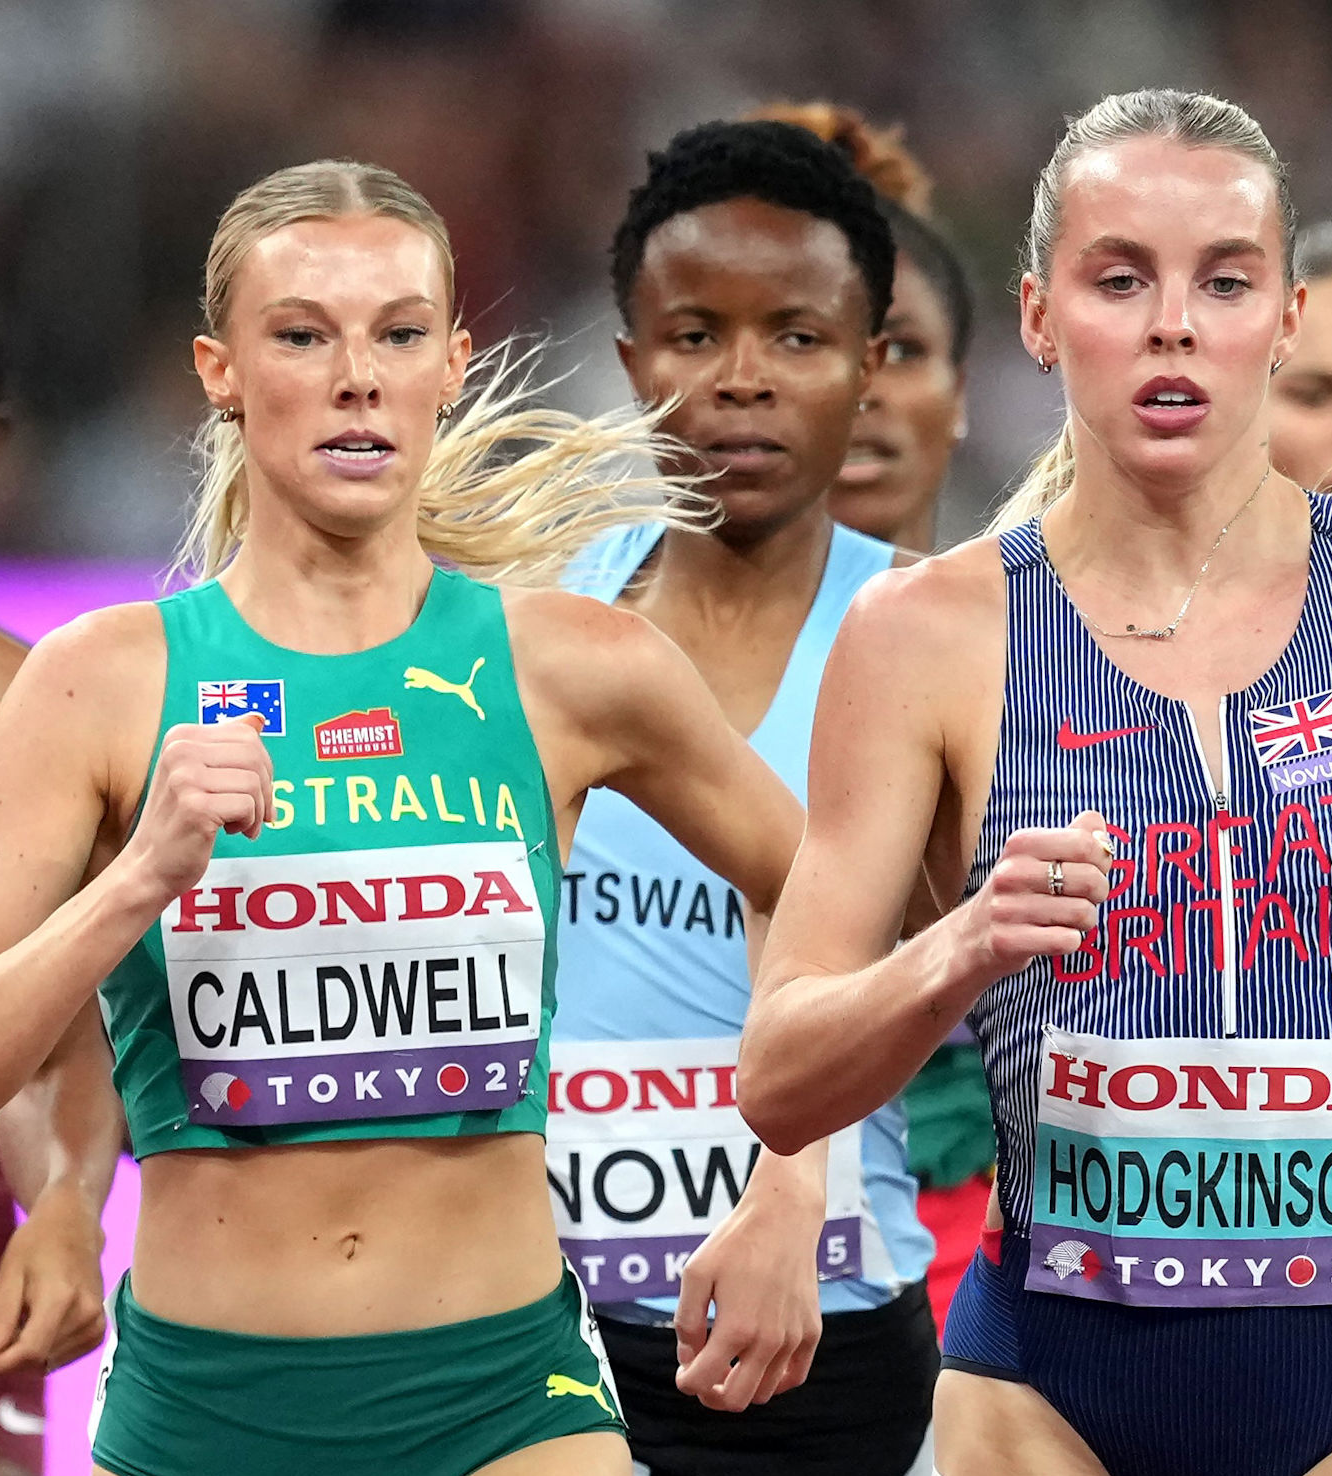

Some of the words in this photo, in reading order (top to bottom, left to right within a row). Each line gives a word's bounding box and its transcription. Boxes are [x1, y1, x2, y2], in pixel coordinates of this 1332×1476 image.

[320, 725, 394, 746] CHEMIST
[321, 741, 395, 755] WAREHOUSE
[265, 774, 525, 840] STRALIA
[171, 870, 533, 932] HONDA
[563, 871, 747, 940] TSWAN
[187, 953, 530, 1049] CALDWELL
[267, 1061, 470, 1106] TOKYO
[547, 1142, 763, 1224] NOW
[581, 1252, 687, 1287] TOK
[826, 1235, 849, 1266] 5
[1113, 1252, 1318, 1289] TOKYO
